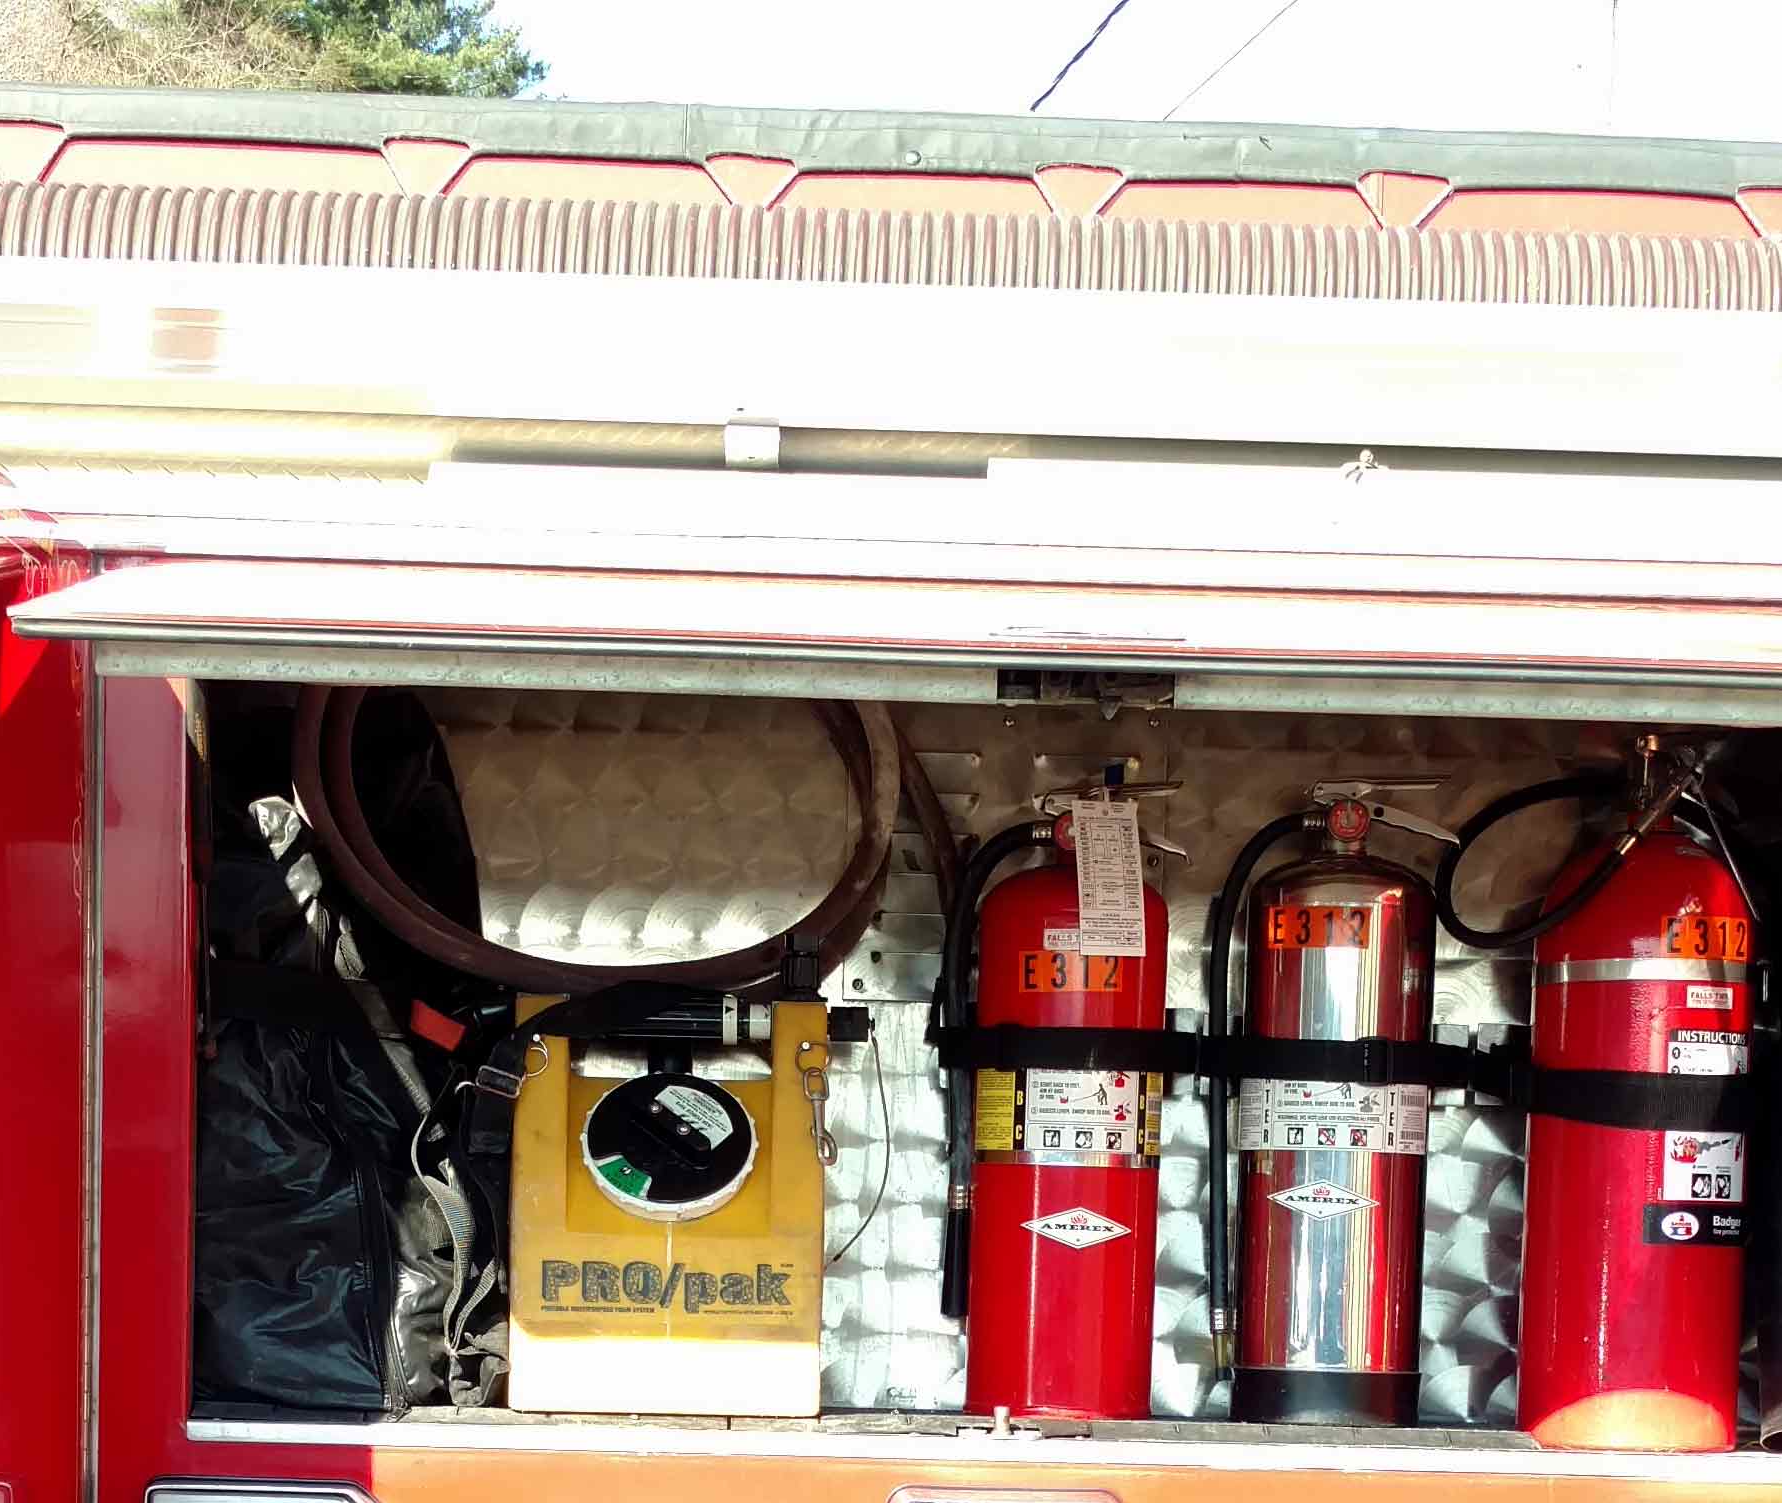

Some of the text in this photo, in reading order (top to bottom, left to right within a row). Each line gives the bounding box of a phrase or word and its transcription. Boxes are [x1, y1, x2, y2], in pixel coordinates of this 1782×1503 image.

[1677, 1030, 1746, 1046] INSTRUCTIONS
[1284, 1194, 1360, 1205] AMEREX
[1040, 1222, 1115, 1233] AMEREX
[541, 1260, 792, 1314] PRO/pak
